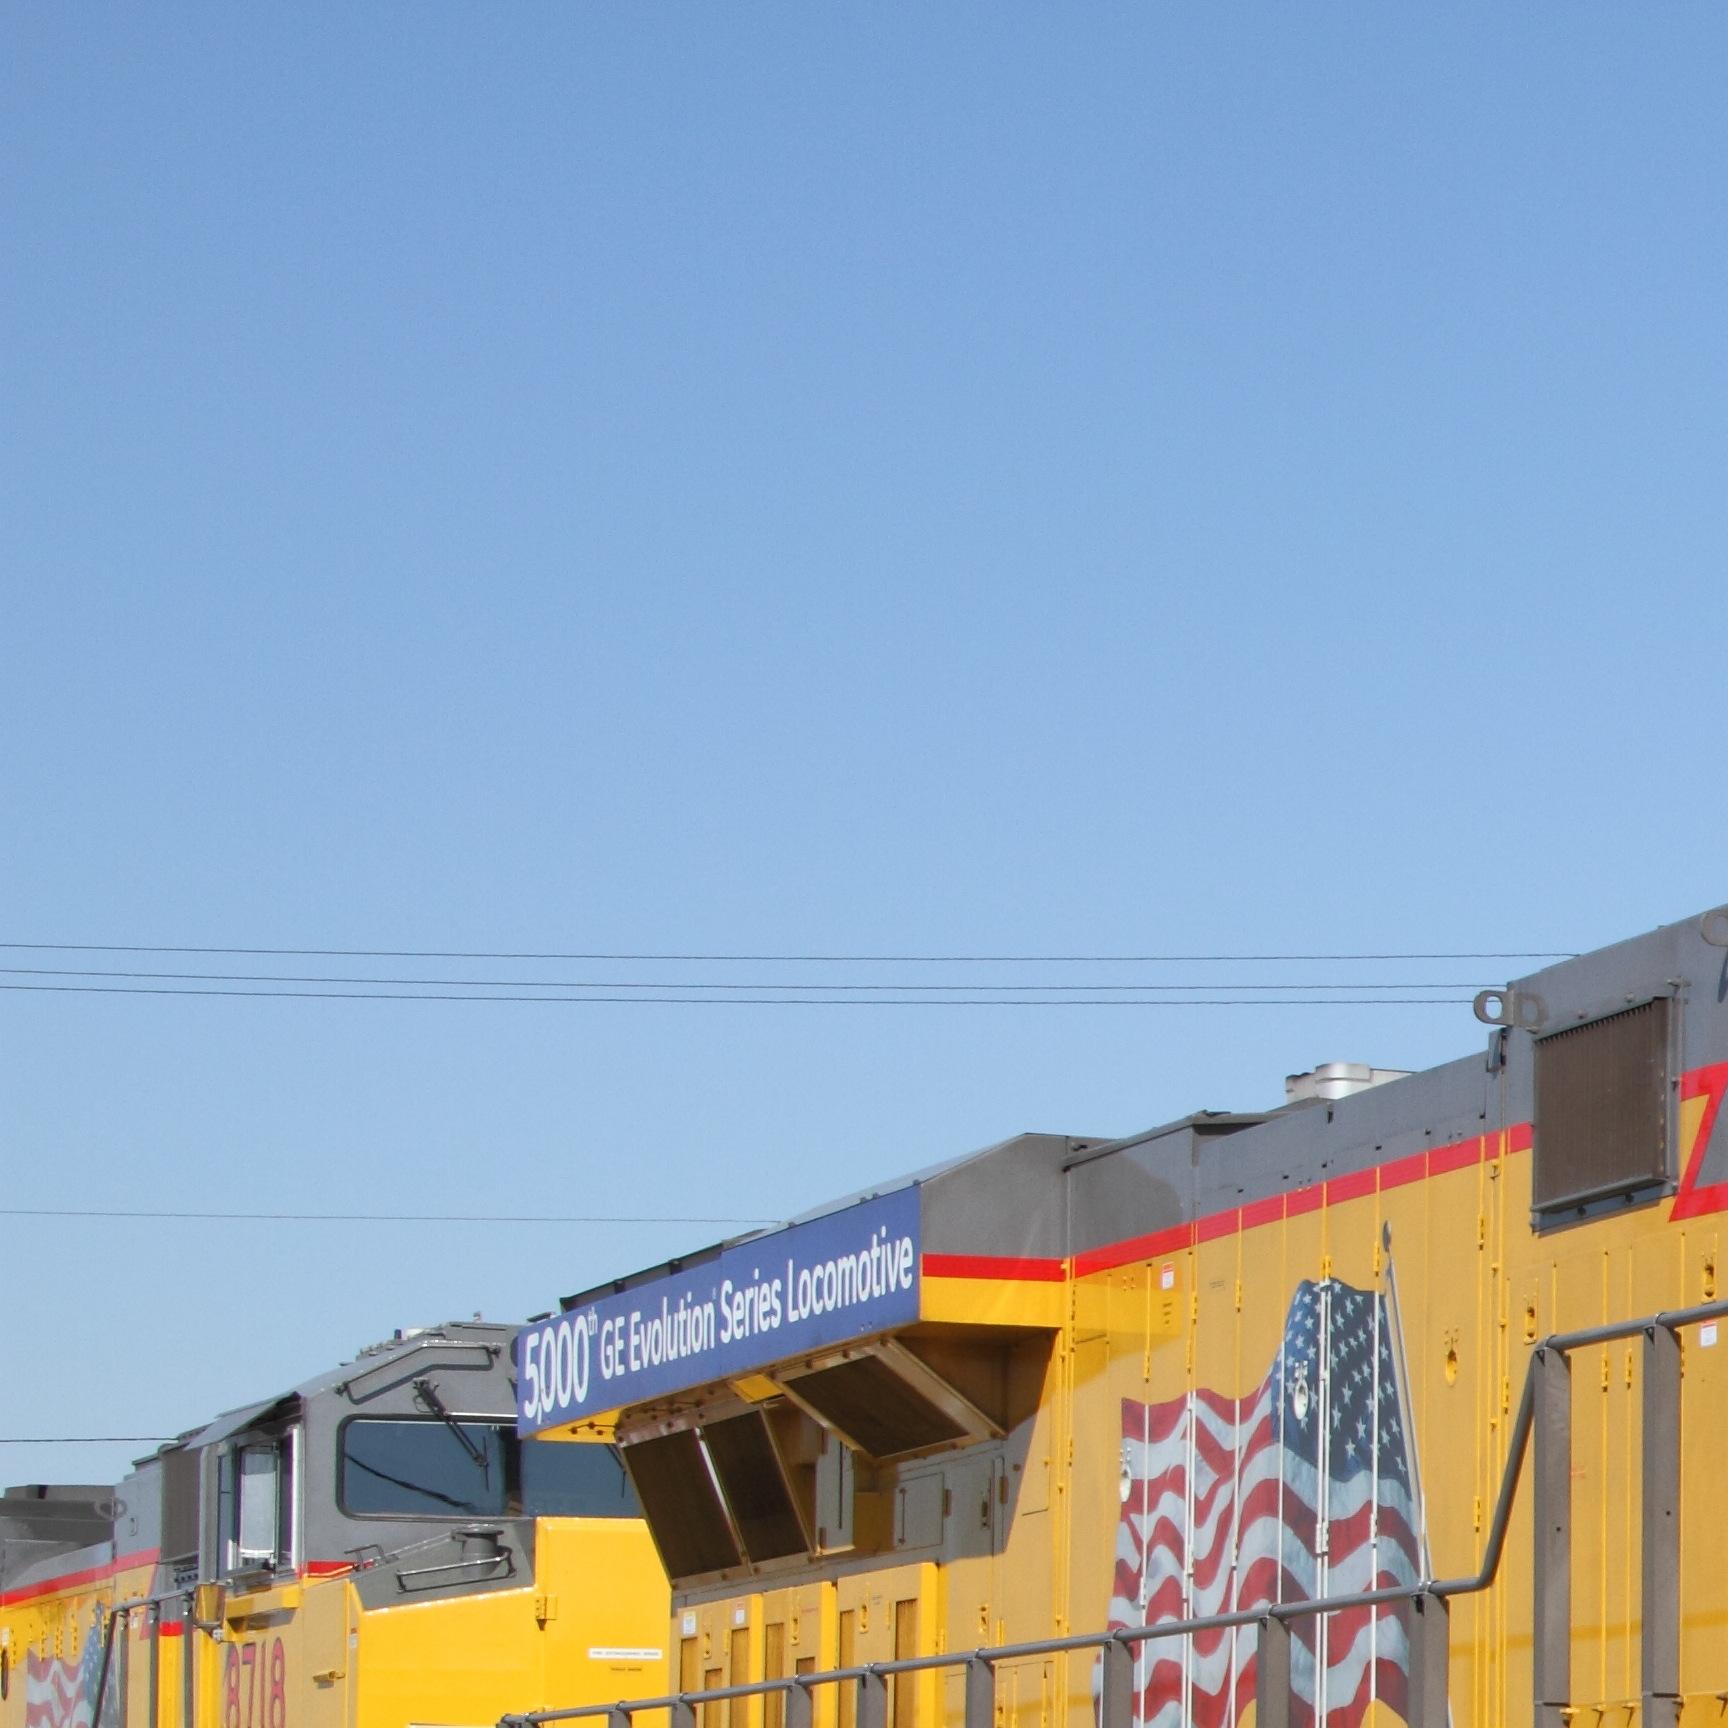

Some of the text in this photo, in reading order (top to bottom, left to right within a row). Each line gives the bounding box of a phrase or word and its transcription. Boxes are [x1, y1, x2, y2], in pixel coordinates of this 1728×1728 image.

[600, 1315, 626, 1380] GE
[719, 1268, 782, 1345] Series
[786, 1225, 914, 1324] Locomotive
